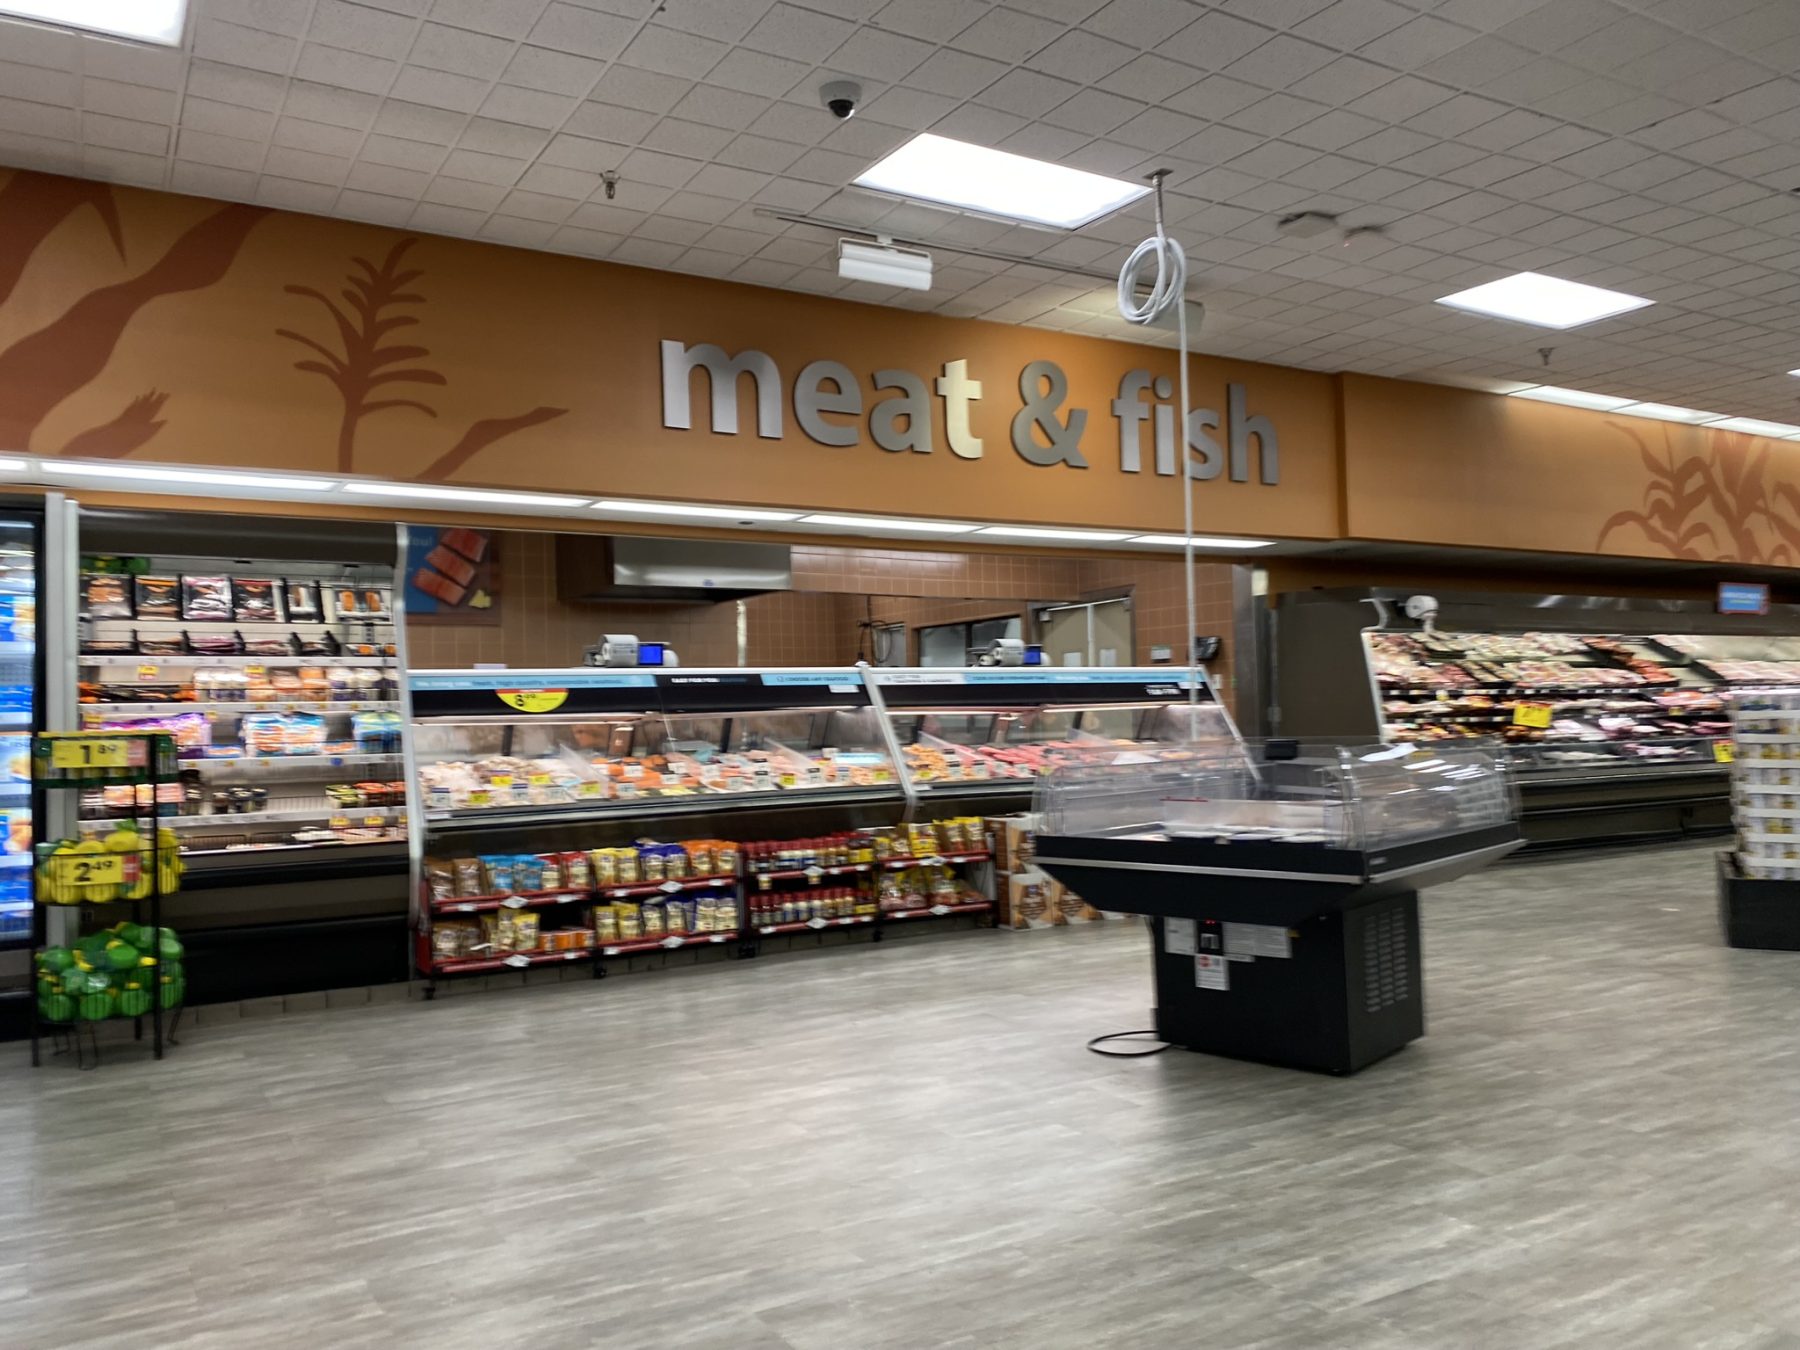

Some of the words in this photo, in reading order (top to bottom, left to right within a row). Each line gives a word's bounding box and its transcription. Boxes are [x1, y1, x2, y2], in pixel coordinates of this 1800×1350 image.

[660, 339, 984, 459] meat
[1010, 360, 1089, 469] &
[1111, 367, 1280, 485] fish
